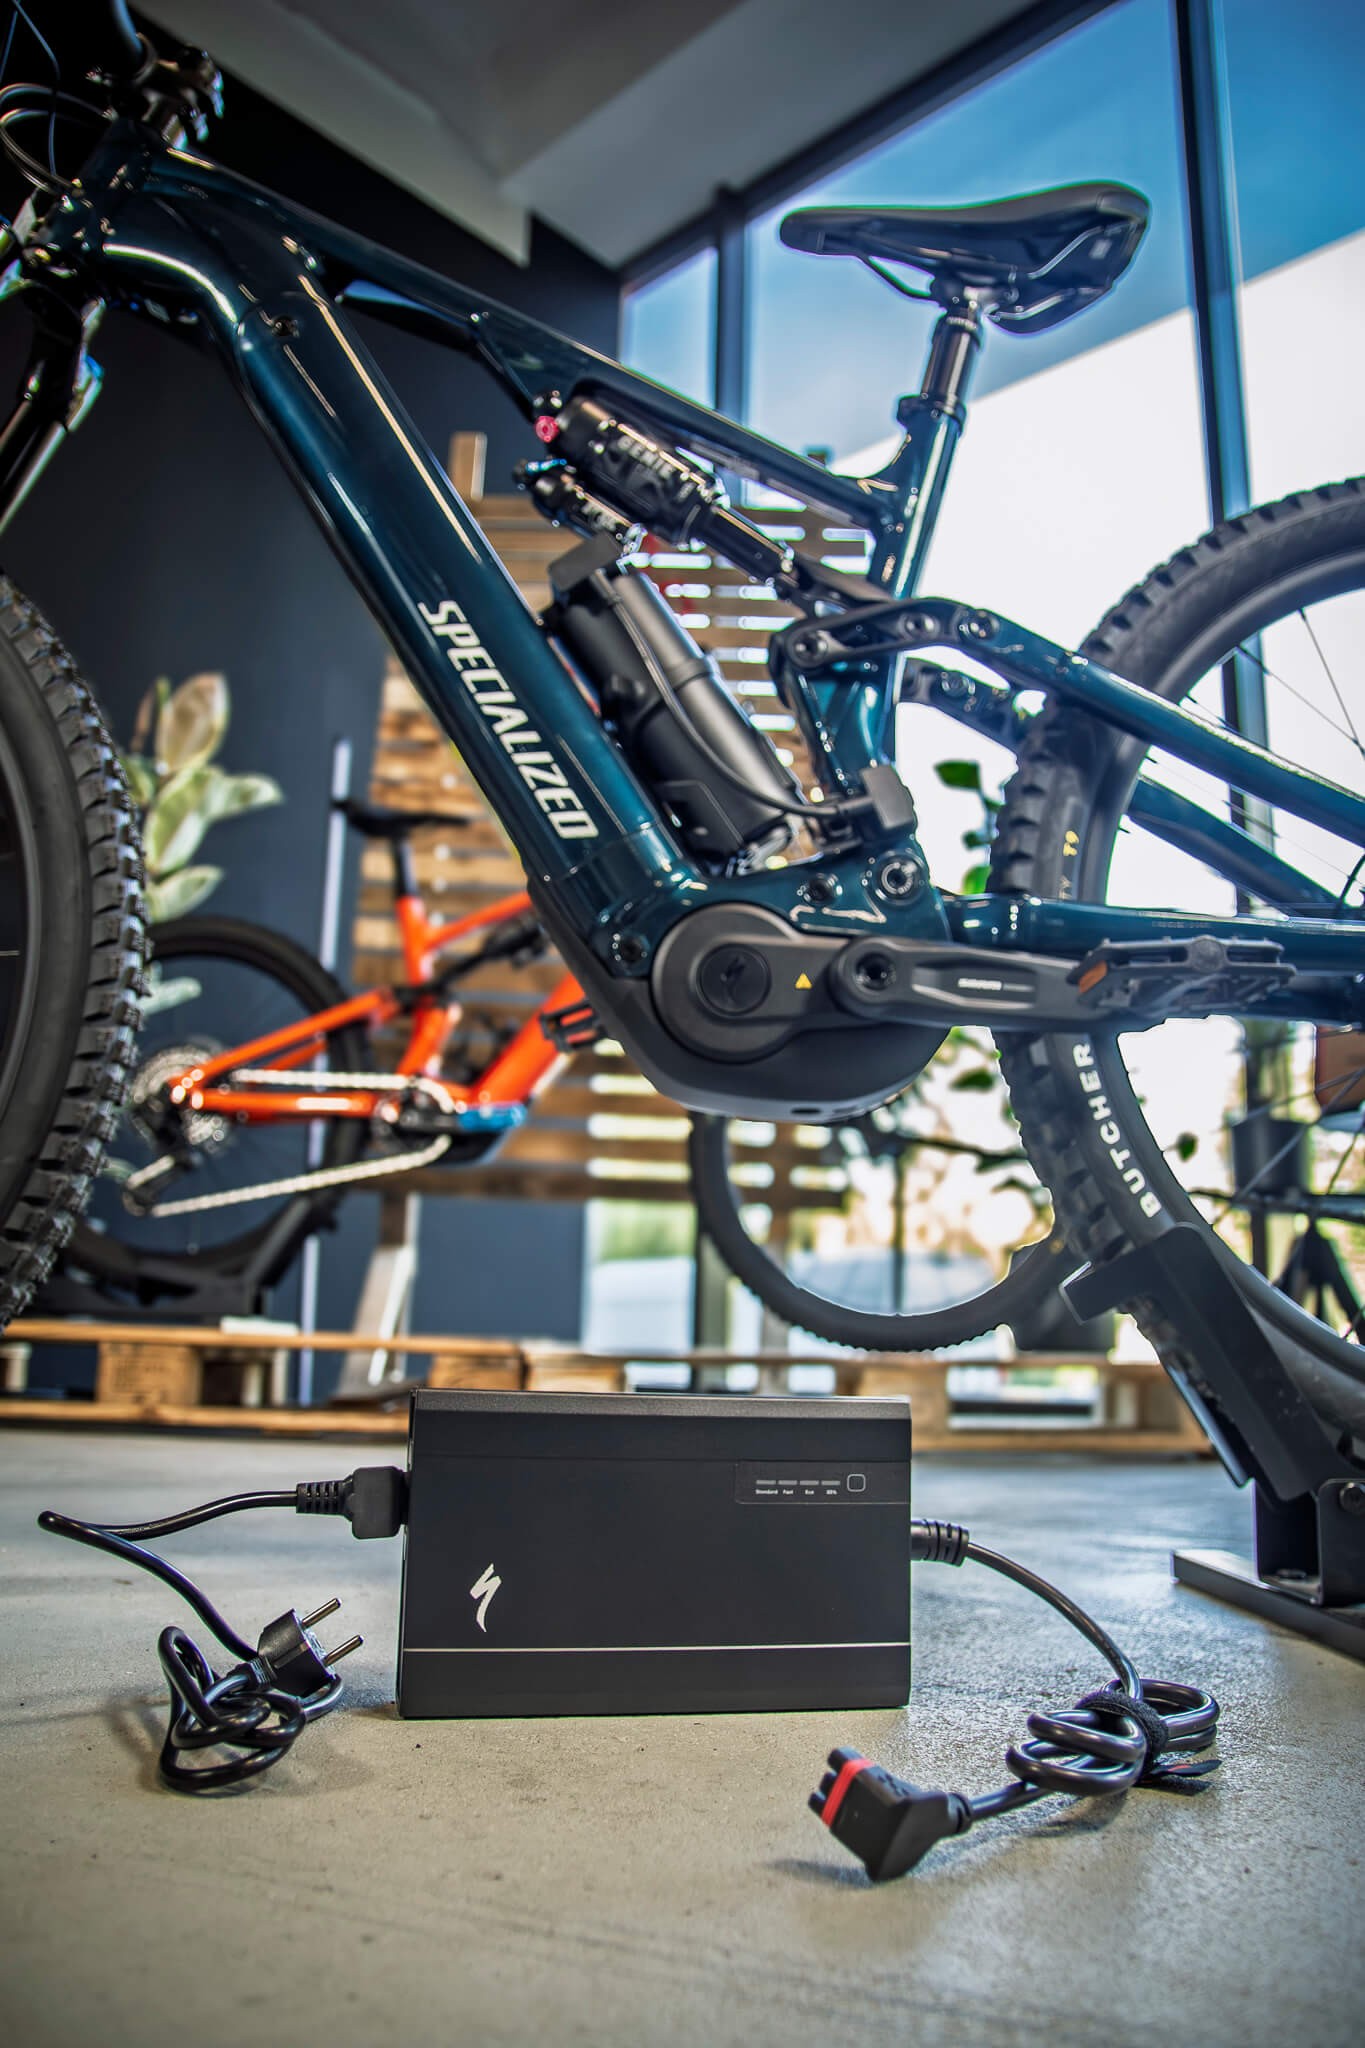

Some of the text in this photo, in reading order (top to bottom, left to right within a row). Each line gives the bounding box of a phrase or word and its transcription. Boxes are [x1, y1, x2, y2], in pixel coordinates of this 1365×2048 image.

[617, 434, 676, 480] GENIE
[417, 600, 599, 839] SPECIALIZED
[1072, 1043, 1162, 1218] BUTCHER
